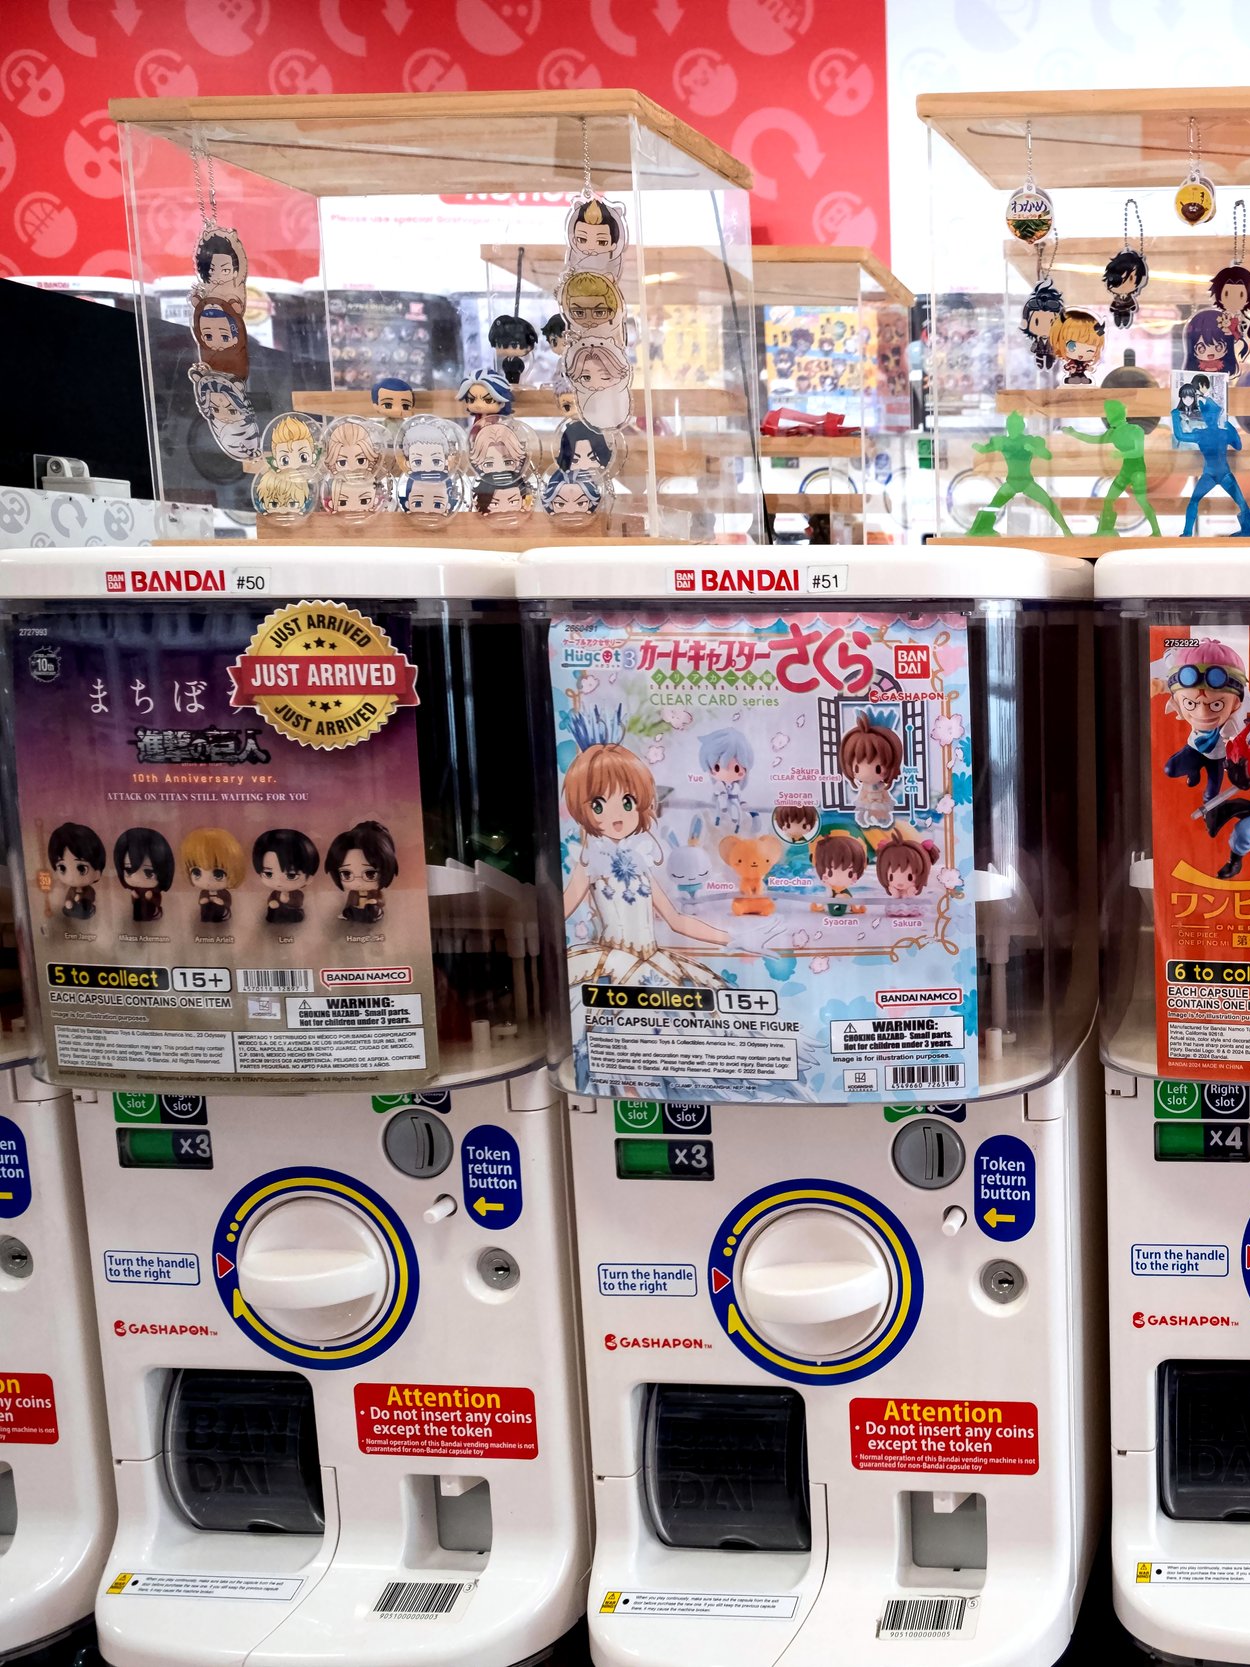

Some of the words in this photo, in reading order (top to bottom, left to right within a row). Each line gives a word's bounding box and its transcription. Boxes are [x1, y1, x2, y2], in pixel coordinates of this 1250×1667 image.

[1012, 200, 1048, 213] わかめ
[131, 570, 226, 592] BANDAI
[237, 576, 265, 590] #50
[702, 570, 799, 591] BANDAI
[812, 575, 839, 589] #51
[269, 618, 303, 649] JUST
[307, 614, 371, 648] ARRIVED
[1164, 639, 1199, 647] 2752922
[637, 640, 772, 672] カードキャプター
[768, 623, 876, 692] さくら
[898, 650, 927, 662] BAN
[898, 662, 922, 675] DAI
[251, 663, 300, 687] JUST
[307, 663, 396, 686] ARRIVED
[650, 693, 693, 706] CLEAR
[698, 694, 738, 706] CARD
[742, 695, 780, 707] series
[881, 693, 944, 701] GASHAPON
[274, 704, 312, 732] JUST
[315, 702, 378, 736] ARRIVED
[791, 767, 820, 775] Sakura
[132, 773, 159, 783] 10th
[165, 774, 244, 786] Anniversary
[251, 775, 277, 783] ver.
[688, 774, 704, 783] Yue
[107, 792, 143, 801] ATTACK
[144, 793, 157, 801] ON
[160, 793, 189, 801] TITAN
[191, 793, 219, 801] STILL
[221, 793, 264, 801] WAITING
[266, 793, 286, 801] FOR
[288, 793, 309, 801] YOU
[778, 791, 813, 800] Syaoran
[707, 882, 734, 890] Momo
[769, 878, 812, 886] Kero-chan
[824, 918, 859, 927] Syaoran
[893, 919, 923, 927] Sakura
[55, 966, 66, 984] 5
[71, 968, 90, 985] to
[98, 970, 159, 988] collect
[327, 973, 366, 982] BANDAI
[366, 972, 407, 980] NAMCO
[1174, 963, 1186, 980] 6
[1193, 965, 1215, 982] to
[180, 972, 224, 988] 15+
[588, 988, 599, 1005] 7
[606, 989, 628, 1006] to
[638, 991, 704, 1008] collect
[1168, 987, 1197, 997] EACH
[1200, 988, 1249, 999] CAPSULE
[725, 994, 770, 1011] 15+
[1168, 999, 1220, 1010] CONTAINS
[1223, 1001, 1247, 1011] ONE
[1167, 1084, 1188, 1094] Left
[1211, 1084, 1240, 1097] Right
[1167, 1096, 1187, 1106] slot
[1215, 1097, 1235, 1107] slot
[1210, 1127, 1243, 1150] x4
[180, 1135, 211, 1157] x3
[1135, 1249, 1161, 1260] Turn
[1165, 1249, 1183, 1260] the
[1186, 1250, 1225, 1261] handle
[1135, 1261, 1147, 1270] to
[1150, 1261, 1169, 1271] the
[1172, 1262, 1199, 1273] right
[1148, 1316, 1230, 1326] GASHAPON
[15, 1396, 52, 1408] coins
[387, 1386, 501, 1409] Attention
